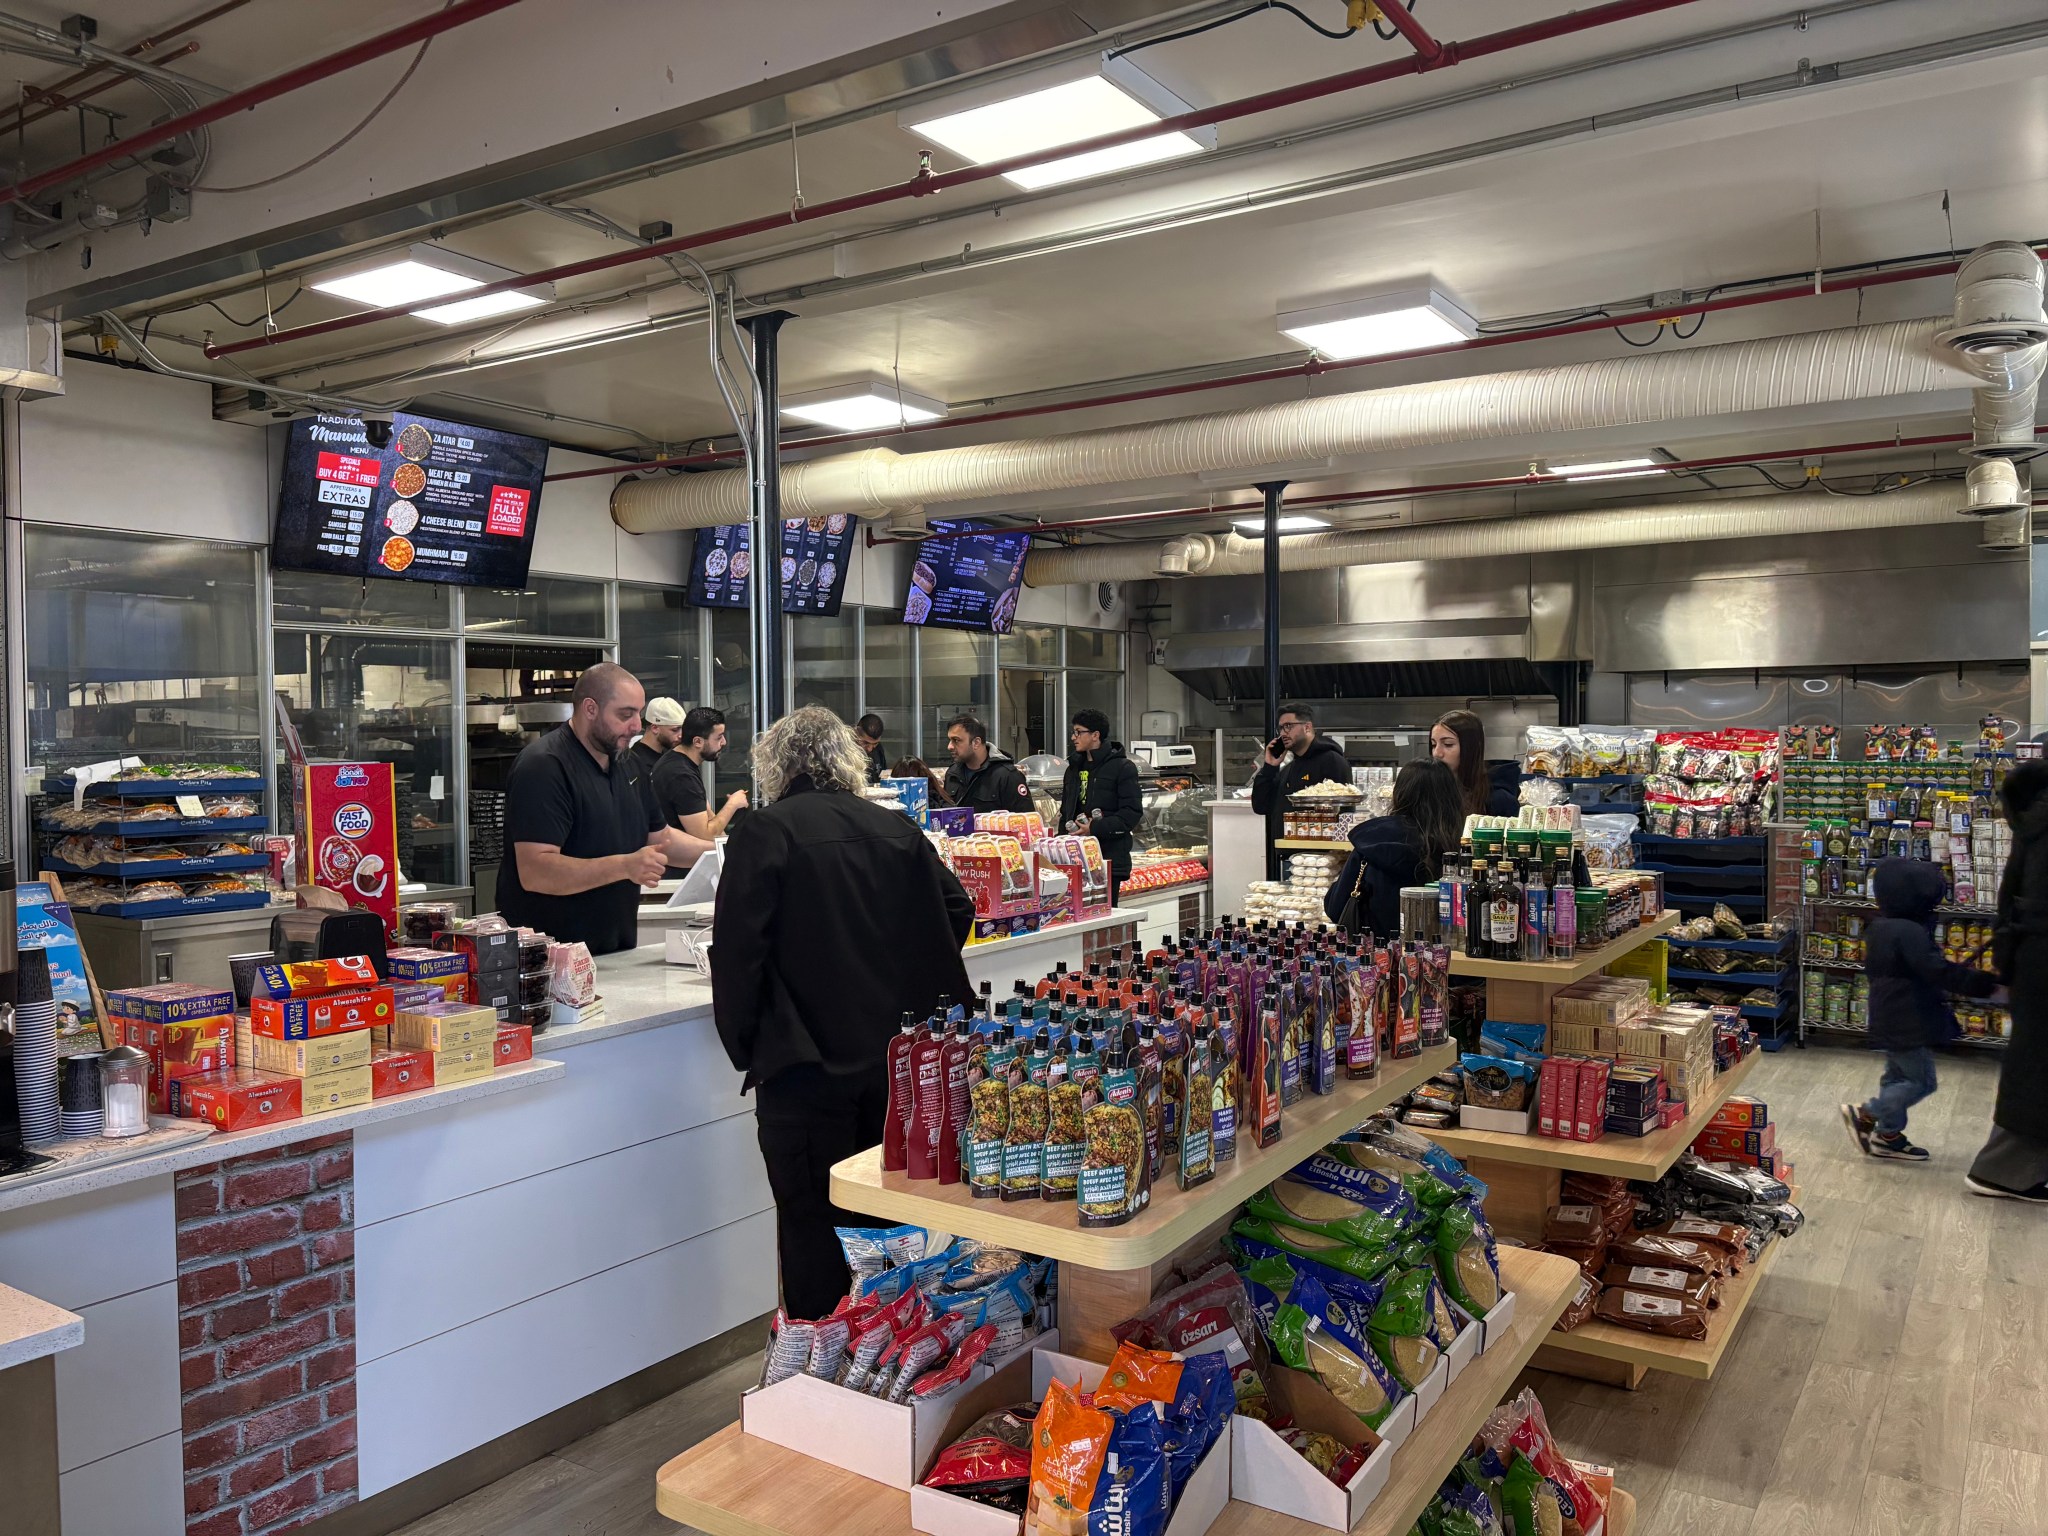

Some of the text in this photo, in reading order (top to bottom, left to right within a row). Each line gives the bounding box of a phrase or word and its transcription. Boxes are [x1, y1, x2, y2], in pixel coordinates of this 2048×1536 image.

[340, 457, 361, 466] SPECIALS
[319, 468, 332, 476] BUY
[332, 470, 338, 478] 4
[338, 471, 350, 480] GET
[428, 469, 453, 480] MEAT PIE
[322, 491, 366, 504] EXTRAS
[494, 504, 524, 516] FULLY
[426, 516, 447, 526] CHEESE
[447, 518, 465, 528] BLEND
[492, 514, 522, 524] LOADED
[338, 811, 364, 822] FAST
[340, 820, 368, 831] FOOD
[418, 958, 466, 974] 10% EXTRA FREE
[50, 970, 72, 979] hool
[167, 996, 230, 1018] 10% EXTRA FREE
[1110, 1088, 1132, 1098] Adonis
[1180, 1320, 1218, 1346] Özsarı
